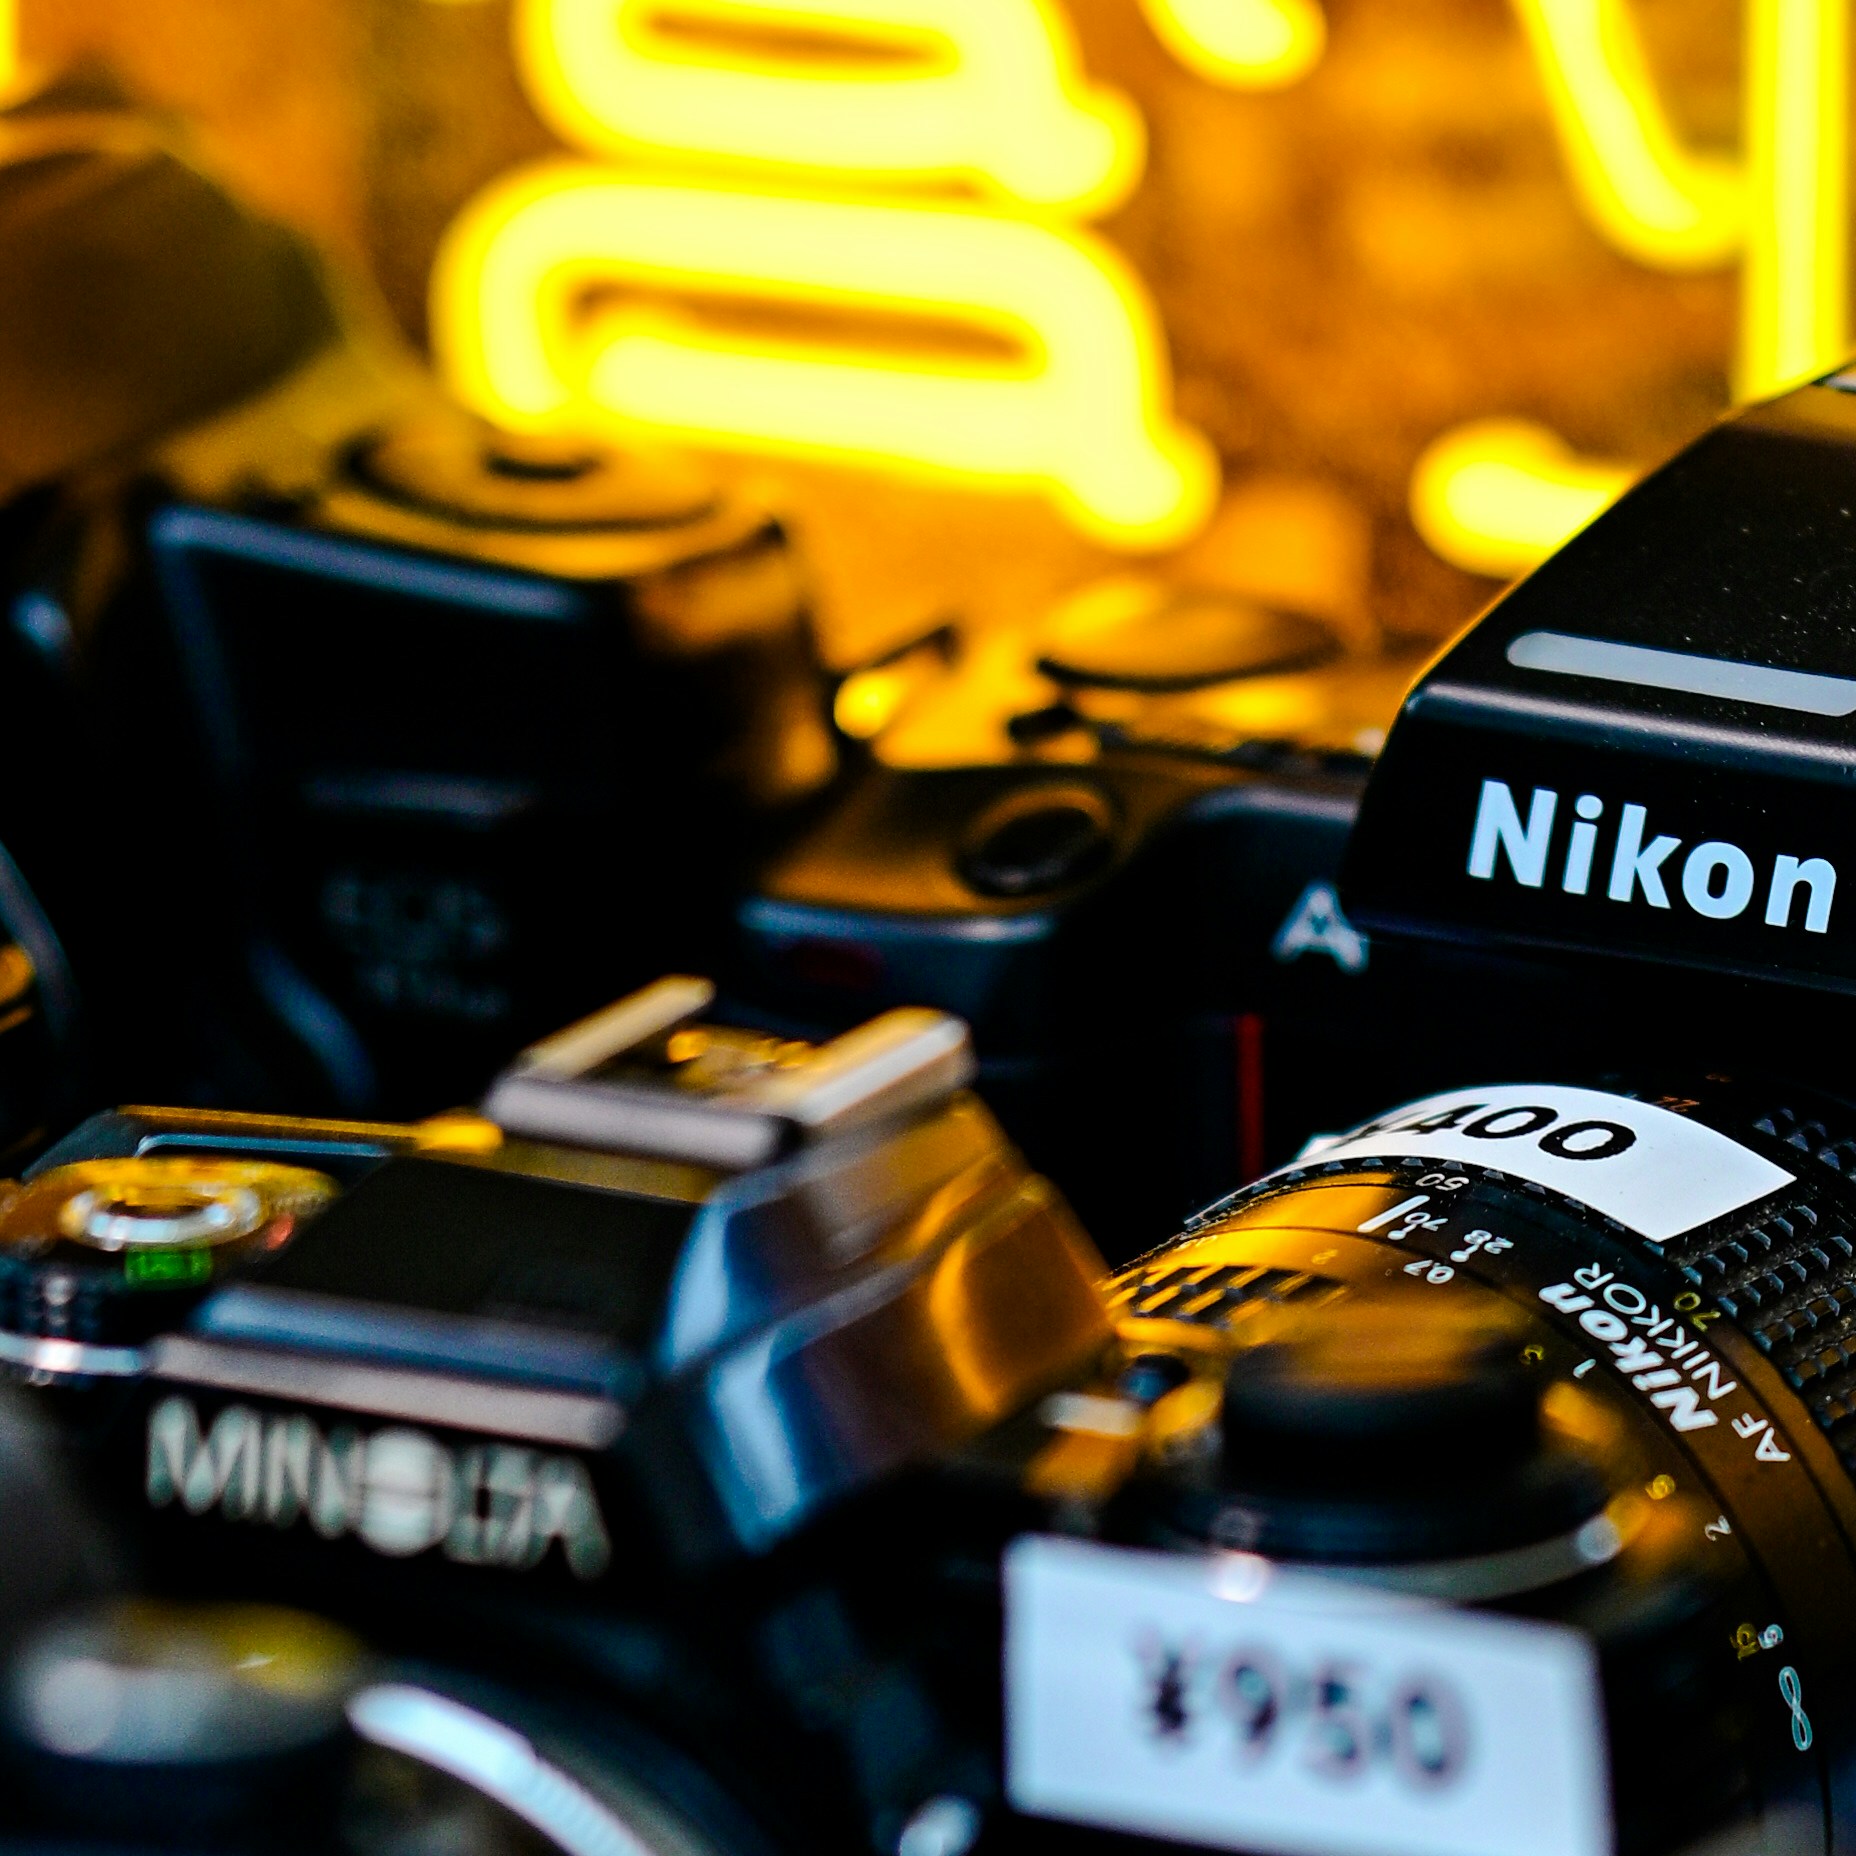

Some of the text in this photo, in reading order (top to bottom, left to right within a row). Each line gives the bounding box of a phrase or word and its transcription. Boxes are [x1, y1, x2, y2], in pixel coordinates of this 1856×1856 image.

[1467, 778, 1837, 934] Nikon
[1403, 1211, 1450, 1232] 70
[1414, 1172, 1470, 1192] 50
[1538, 1282, 1719, 1432] Nikon
[1573, 1262, 1792, 1462] AF NIKKOR
[1673, 1292, 1722, 1332] 70
[1135, 1625, 1468, 1795] ¥950
